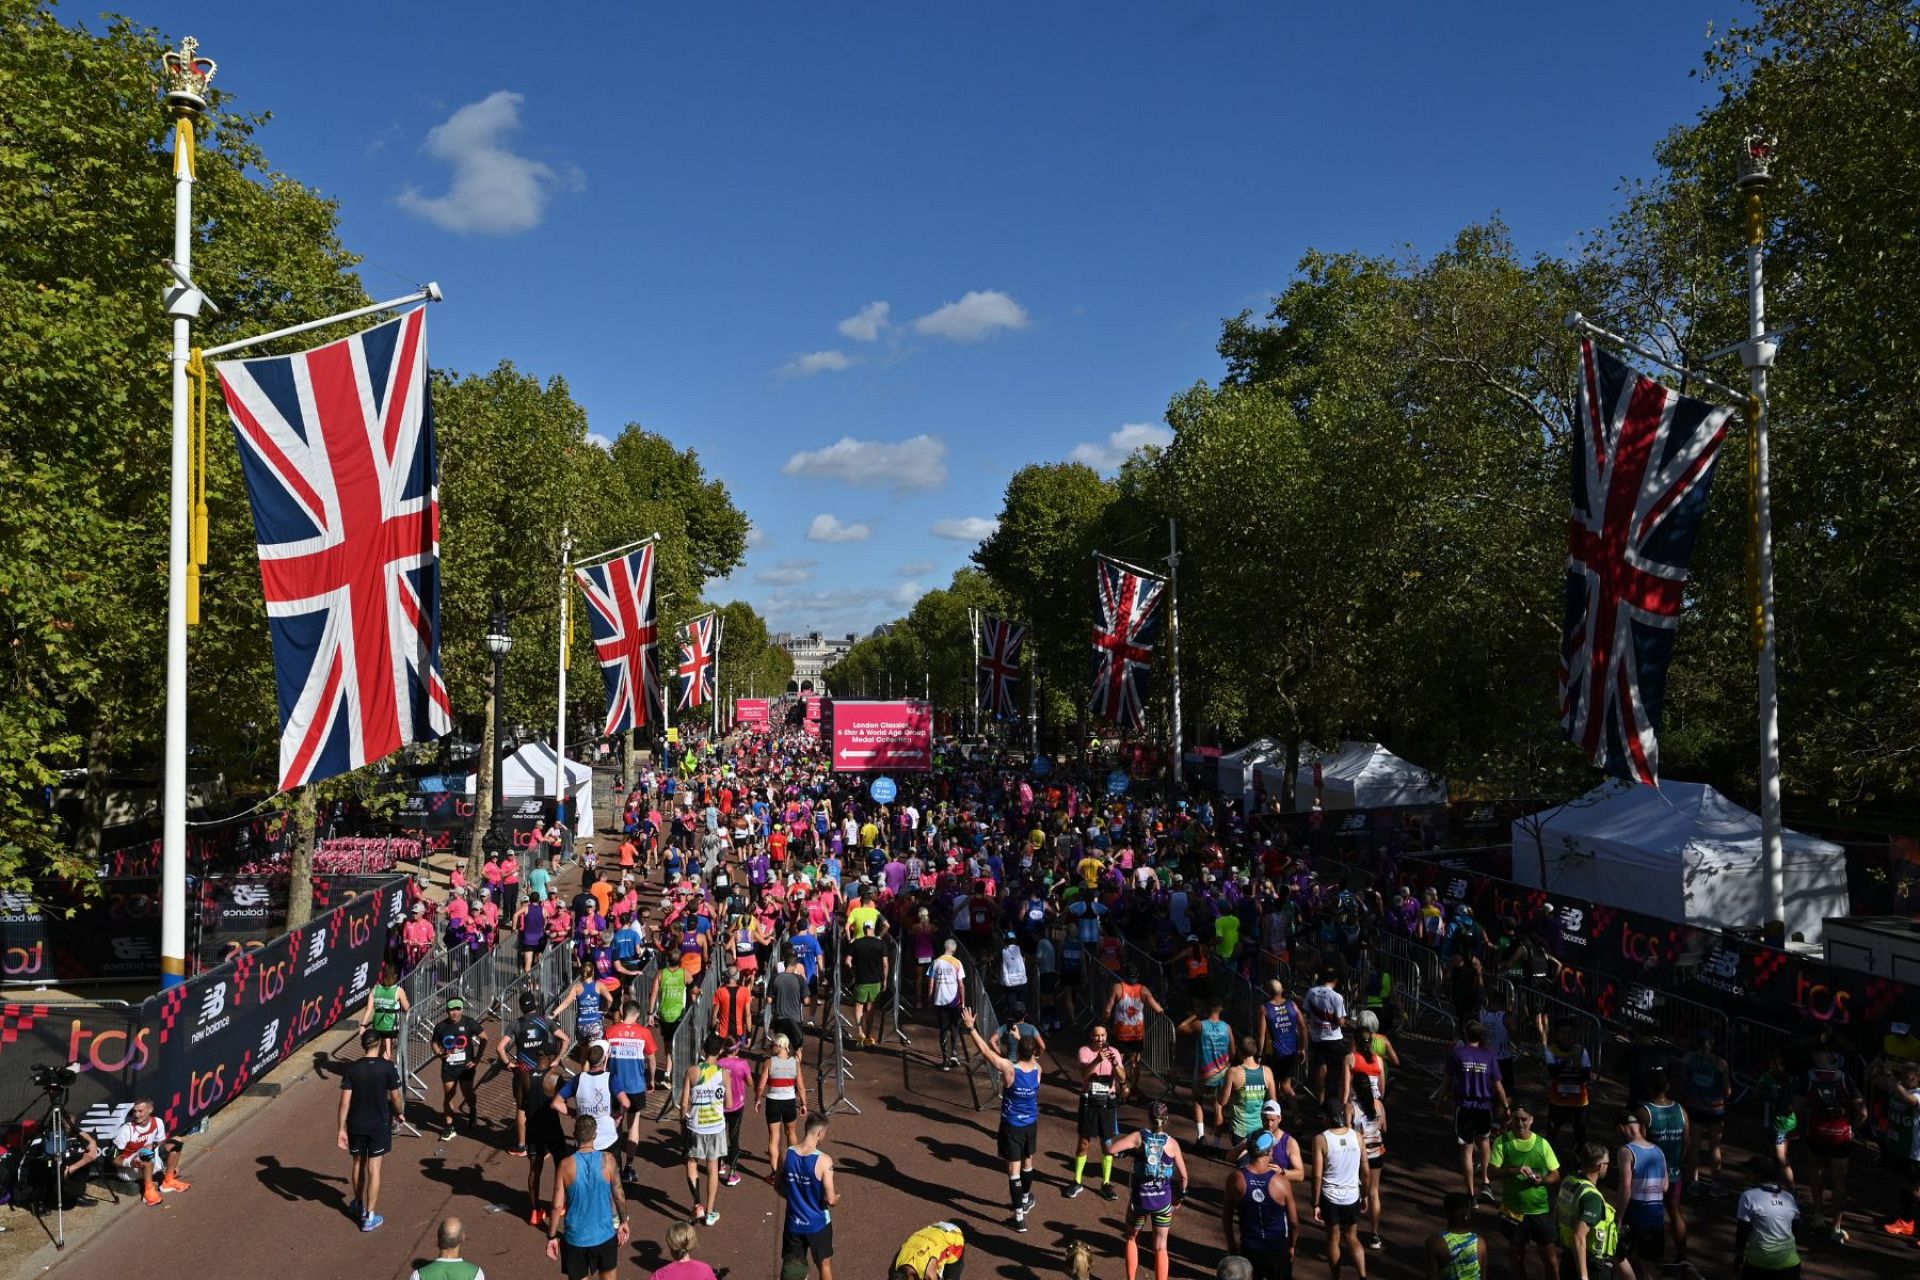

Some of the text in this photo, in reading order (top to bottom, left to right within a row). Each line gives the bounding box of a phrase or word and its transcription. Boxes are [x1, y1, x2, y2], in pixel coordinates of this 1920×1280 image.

[456, 799, 475, 817] tc
[514, 828, 532, 847] tc
[350, 914, 370, 949] tcs
[1622, 921, 1660, 963] tcs
[259, 961, 286, 1004] tcs
[1797, 970, 1851, 1024] tcs
[192, 1016, 230, 1044] new balance
[298, 995, 323, 1036] tcs
[68, 1019, 150, 1073] tcs
[188, 1063, 226, 1116] tcs
